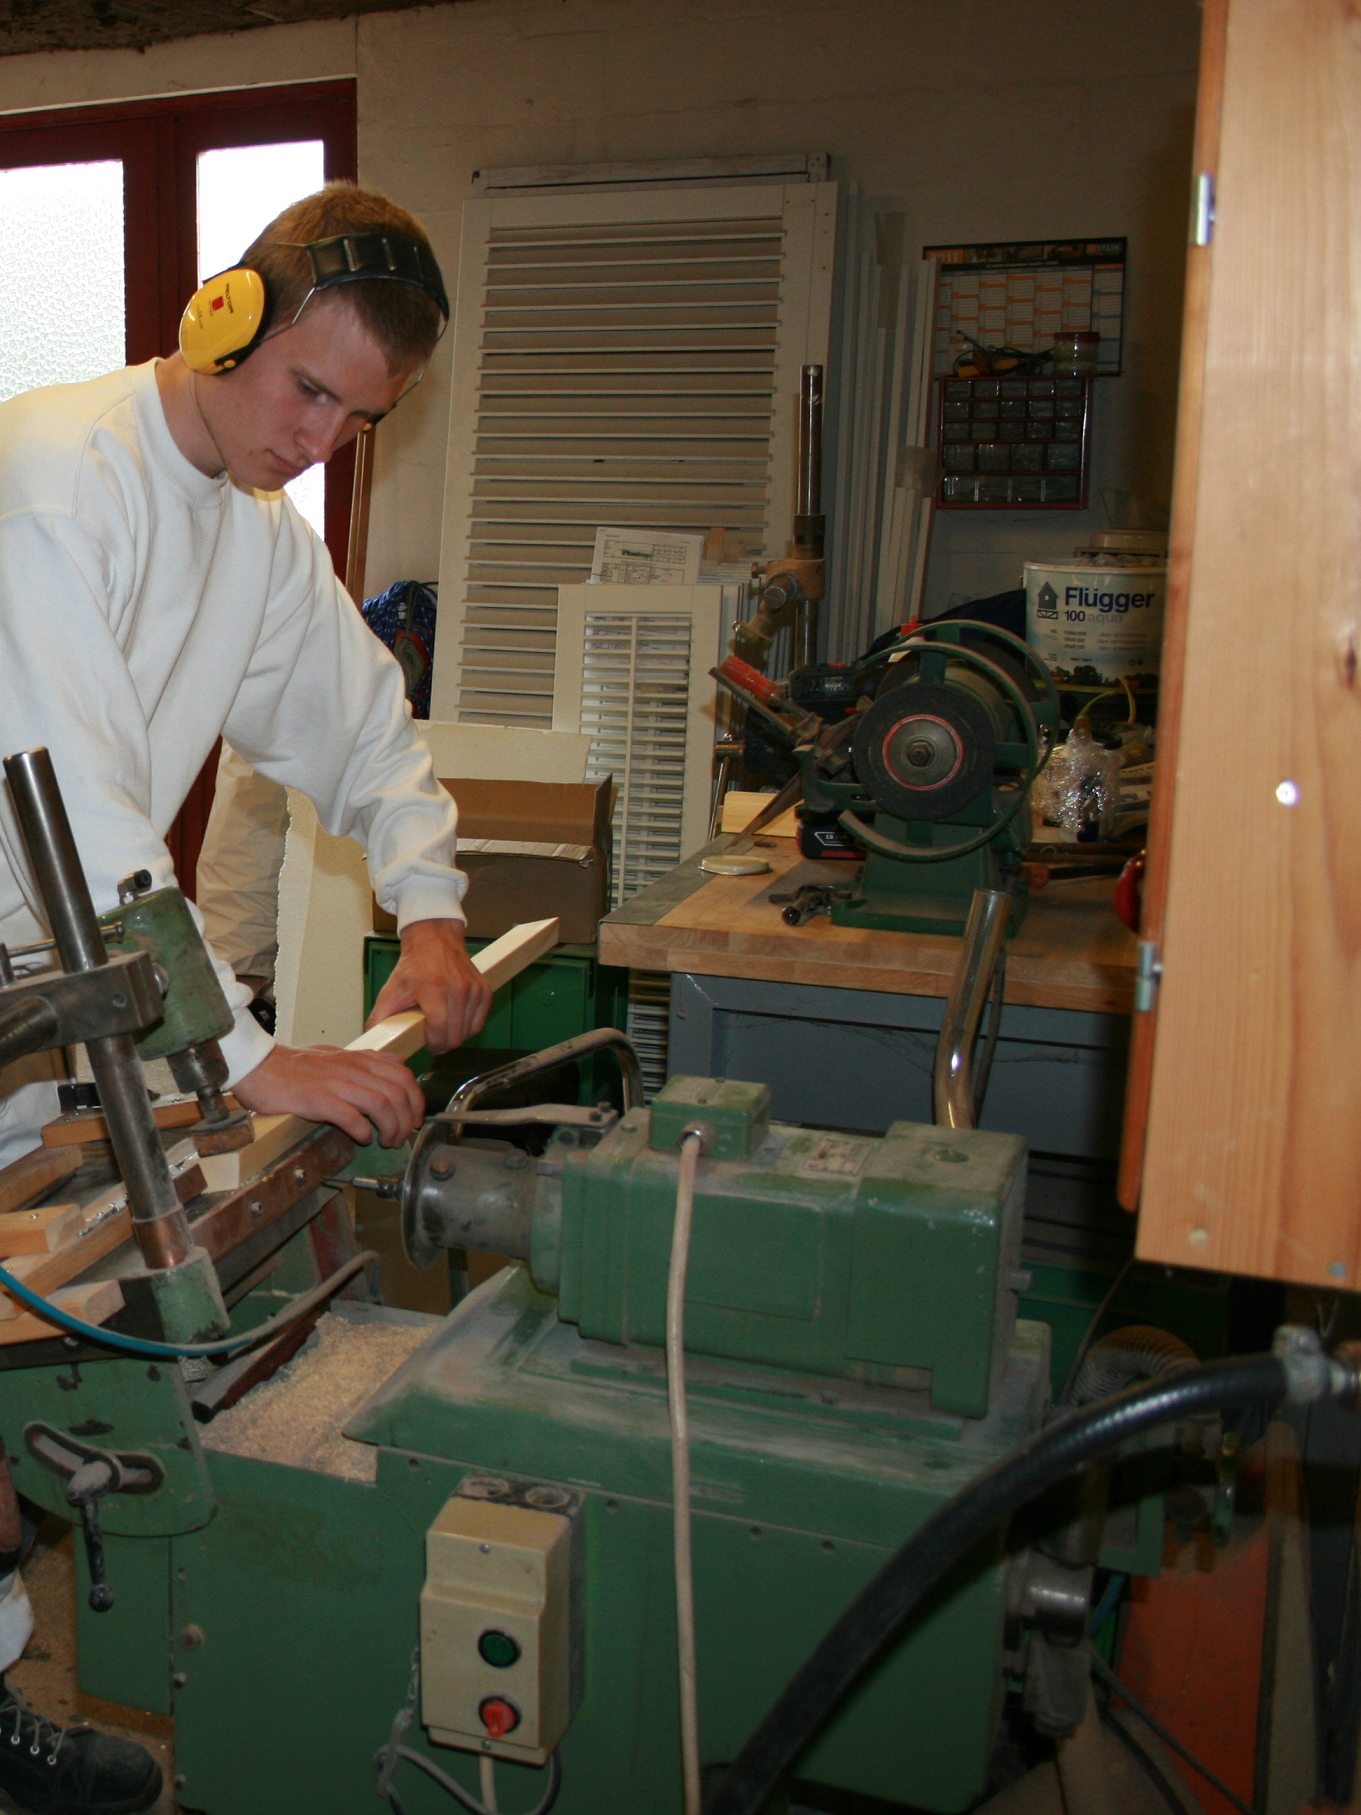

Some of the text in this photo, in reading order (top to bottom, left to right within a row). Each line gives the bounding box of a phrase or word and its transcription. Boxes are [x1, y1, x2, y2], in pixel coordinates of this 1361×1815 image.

[1064, 587, 1155, 613] Flügger
[1064, 610, 1124, 625] 100 aqua
